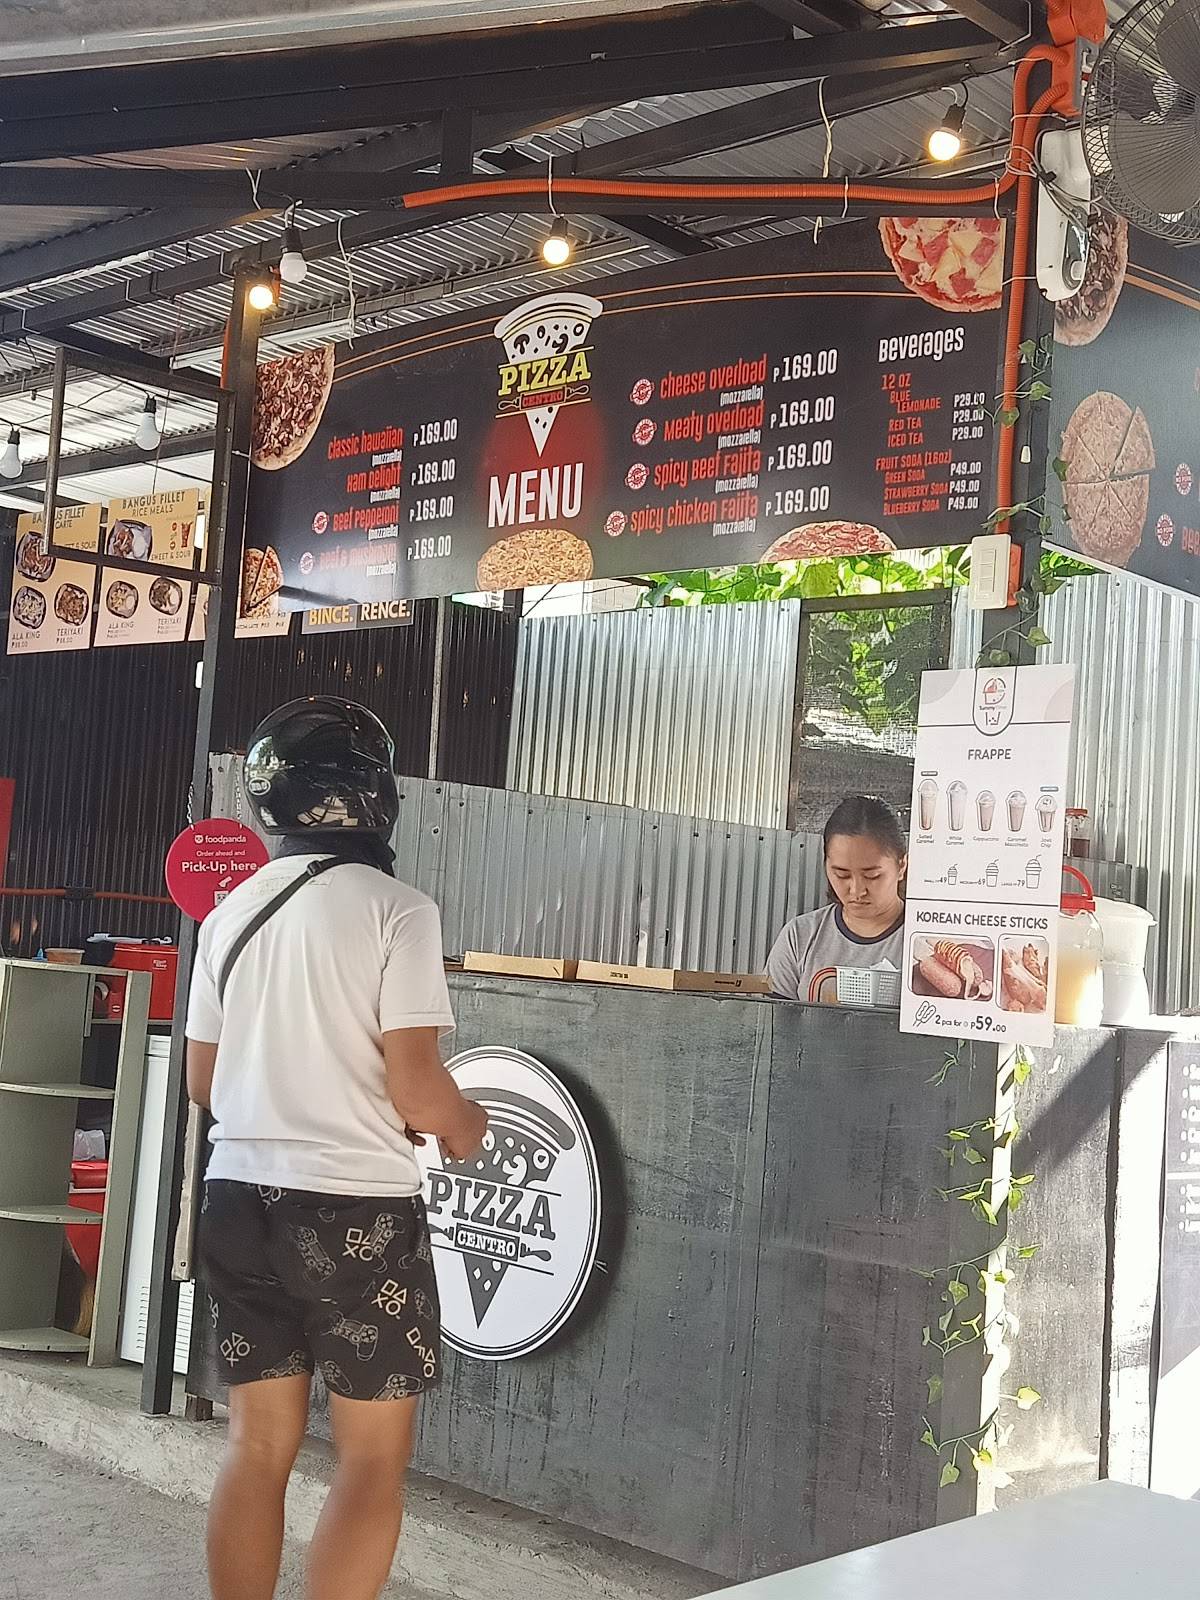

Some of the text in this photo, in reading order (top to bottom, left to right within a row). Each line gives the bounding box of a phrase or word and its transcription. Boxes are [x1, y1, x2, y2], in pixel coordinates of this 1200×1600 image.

[878, 327, 965, 363] Beverages
[498, 351, 592, 396] PIZZA
[881, 373, 912, 390] 12 OZ
[522, 391, 564, 408] CENTRO
[888, 418, 904, 432] RED
[907, 416, 922, 430] TEA
[888, 426, 983, 448] ICED TEA P29.00
[691, 450, 720, 481] Beef
[723, 446, 761, 478] Fajita
[875, 456, 899, 471] FRUIT
[901, 453, 922, 468] SODA
[907, 468, 926, 483] SODA
[950, 461, 982, 477] P49.00
[487, 462, 584, 528] MENU
[930, 482, 948, 496] SODA
[949, 479, 980, 494] P49.00
[122, 491, 186, 509] BANGUS FILLET
[721, 490, 759, 521] Fajita
[921, 498, 940, 513] SODA
[947, 497, 979, 511] P49.00
[64, 507, 85, 519] FILLET
[132, 504, 174, 517] RICE MEALS
[11, 631, 41, 641] ALA KING
[56, 627, 84, 637] TERIYAKI
[967, 748, 1012, 761] FRAPPE
[205, 835, 247, 845] foodpanda
[181, 861, 227, 874] Pick-Up
[916, 911, 1048, 930] KOREAN CHEESE STICKS
[935, 1015, 941, 1025] 2
[427, 1173, 557, 1241] PIZZA
[456, 1229, 517, 1258] CENTRO
